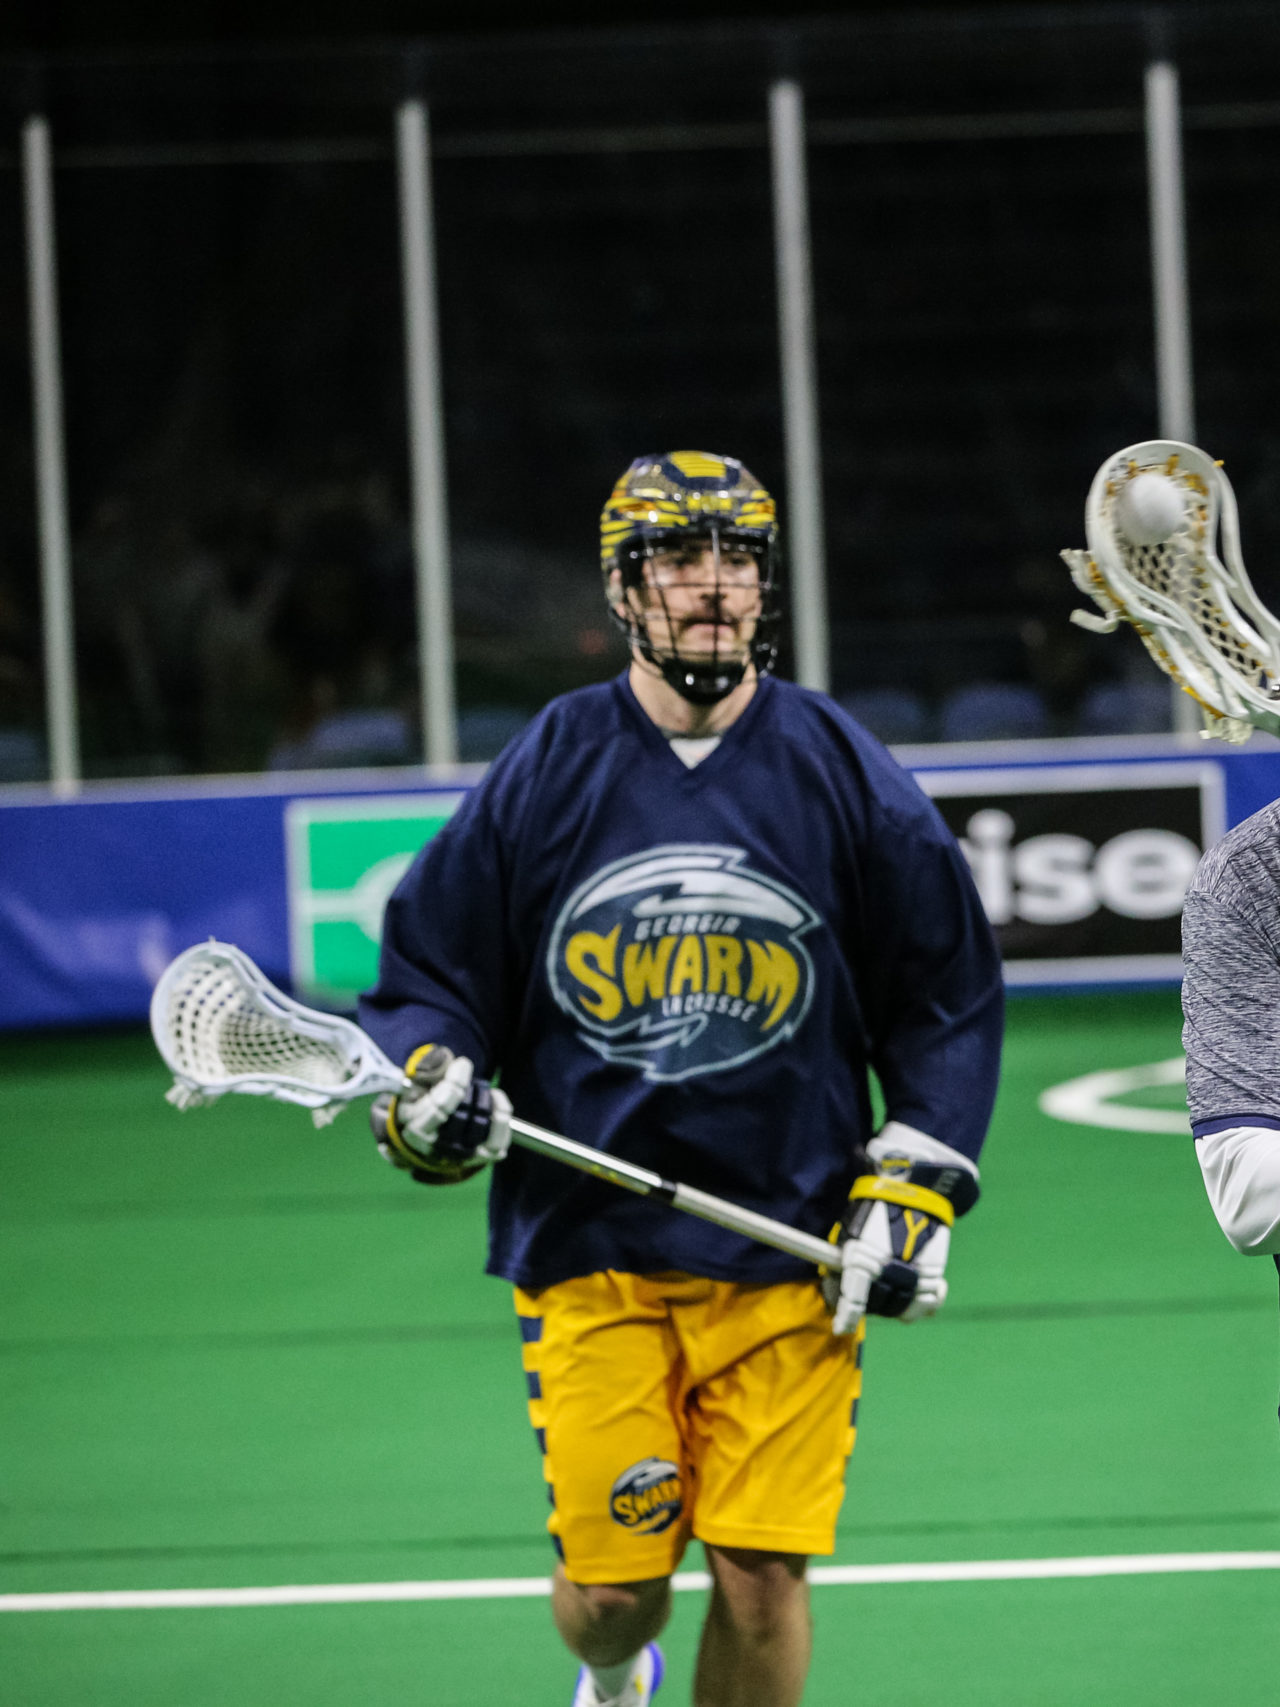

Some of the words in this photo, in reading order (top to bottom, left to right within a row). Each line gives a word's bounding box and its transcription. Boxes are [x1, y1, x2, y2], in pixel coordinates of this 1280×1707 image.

[957, 808, 1200, 926] ise
[564, 922, 800, 1032] SWARM
[633, 913, 742, 942] GEORGIA
